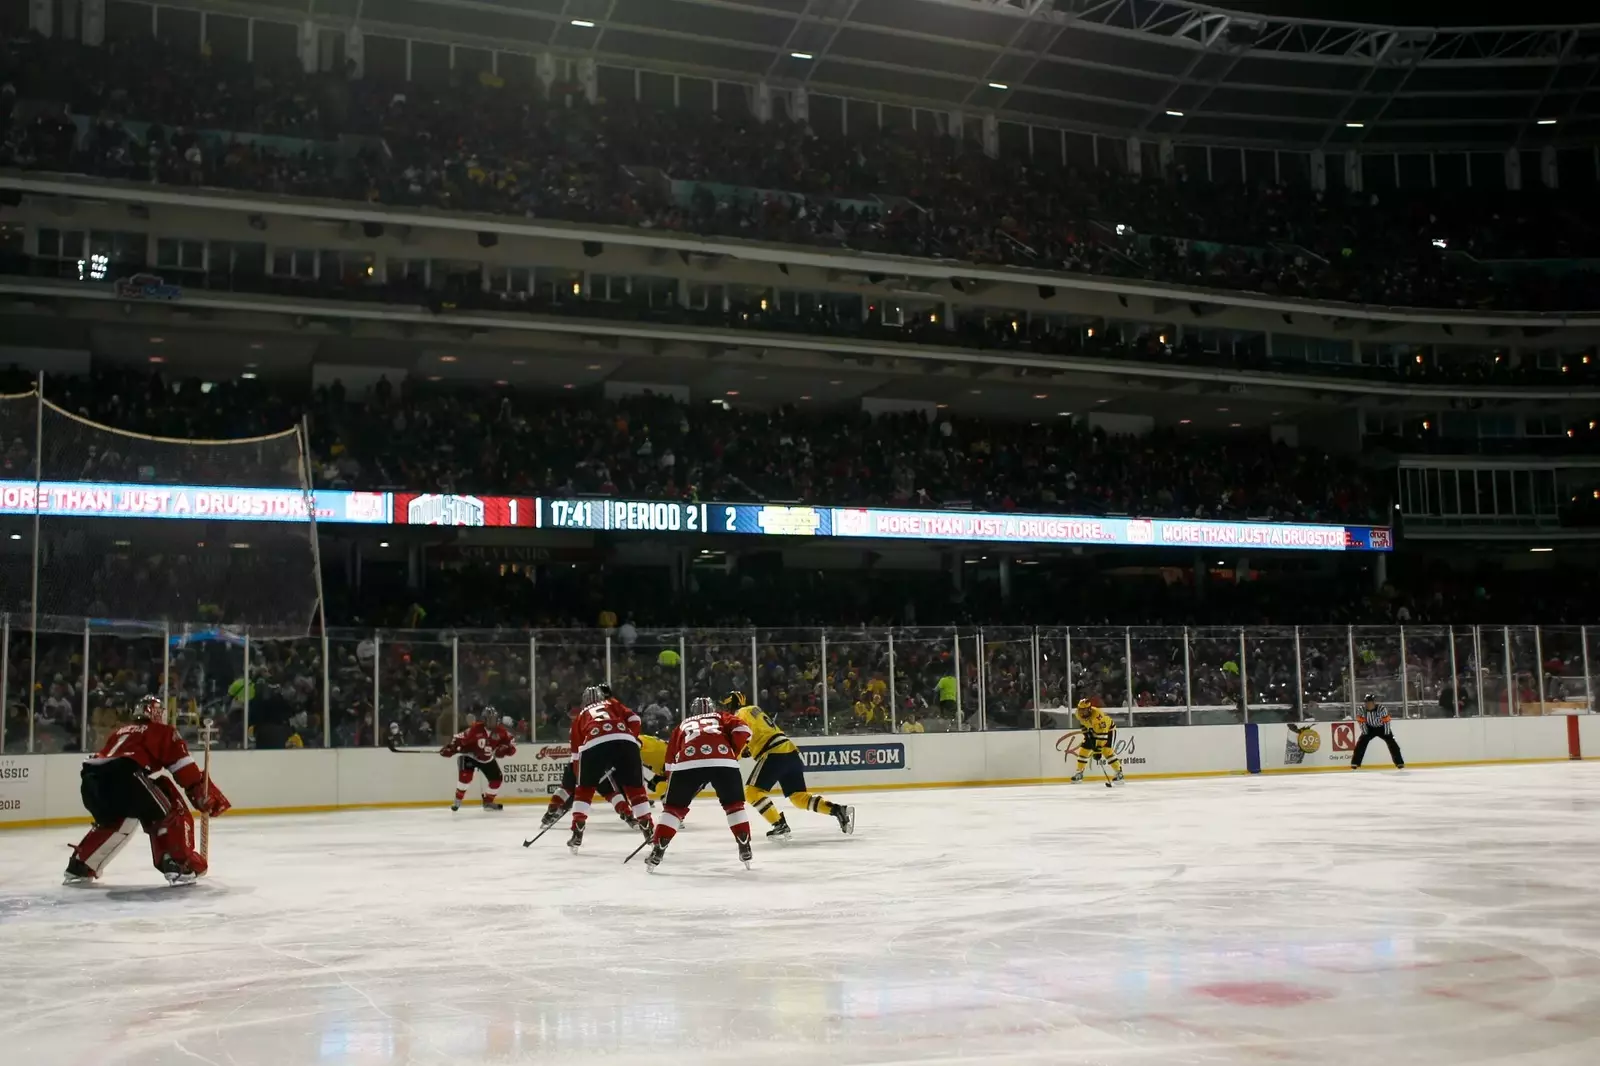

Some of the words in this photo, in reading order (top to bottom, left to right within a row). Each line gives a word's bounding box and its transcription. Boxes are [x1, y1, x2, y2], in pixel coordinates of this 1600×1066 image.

[54, 489, 112, 511] THAN
[117, 490, 171, 512] JUST
[174, 491, 191, 513] A
[508, 500, 518, 525] 1
[550, 500, 593, 527] 17:41
[615, 501, 680, 531] PERIOD
[686, 505, 698, 531] 2
[725, 507, 736, 531] 2
[876, 514, 920, 533] MORE
[922, 516, 964, 535] THAN
[967, 518, 1003, 537] JUST
[1004, 519, 1018, 537] A
[1162, 524, 1200, 542] MORE
[1200, 526, 1236, 543] THAN
[1237, 527, 1271, 544] JUST
[1270, 528, 1283, 545] A
[1369, 530, 1387, 541] drug
[1372, 538, 1390, 548] mart
[588, 705, 611, 722] 5
[683, 718, 723, 744] 22
[1337, 725, 1350, 747] K
[107, 733, 130, 757] 1
[503, 763, 538, 774] SINGLE
[797, 748, 900, 767] NDIANS.COM
[503, 773, 517, 783] ON
[520, 773, 544, 783] SALE
[0, 799, 21, 811] 2012
